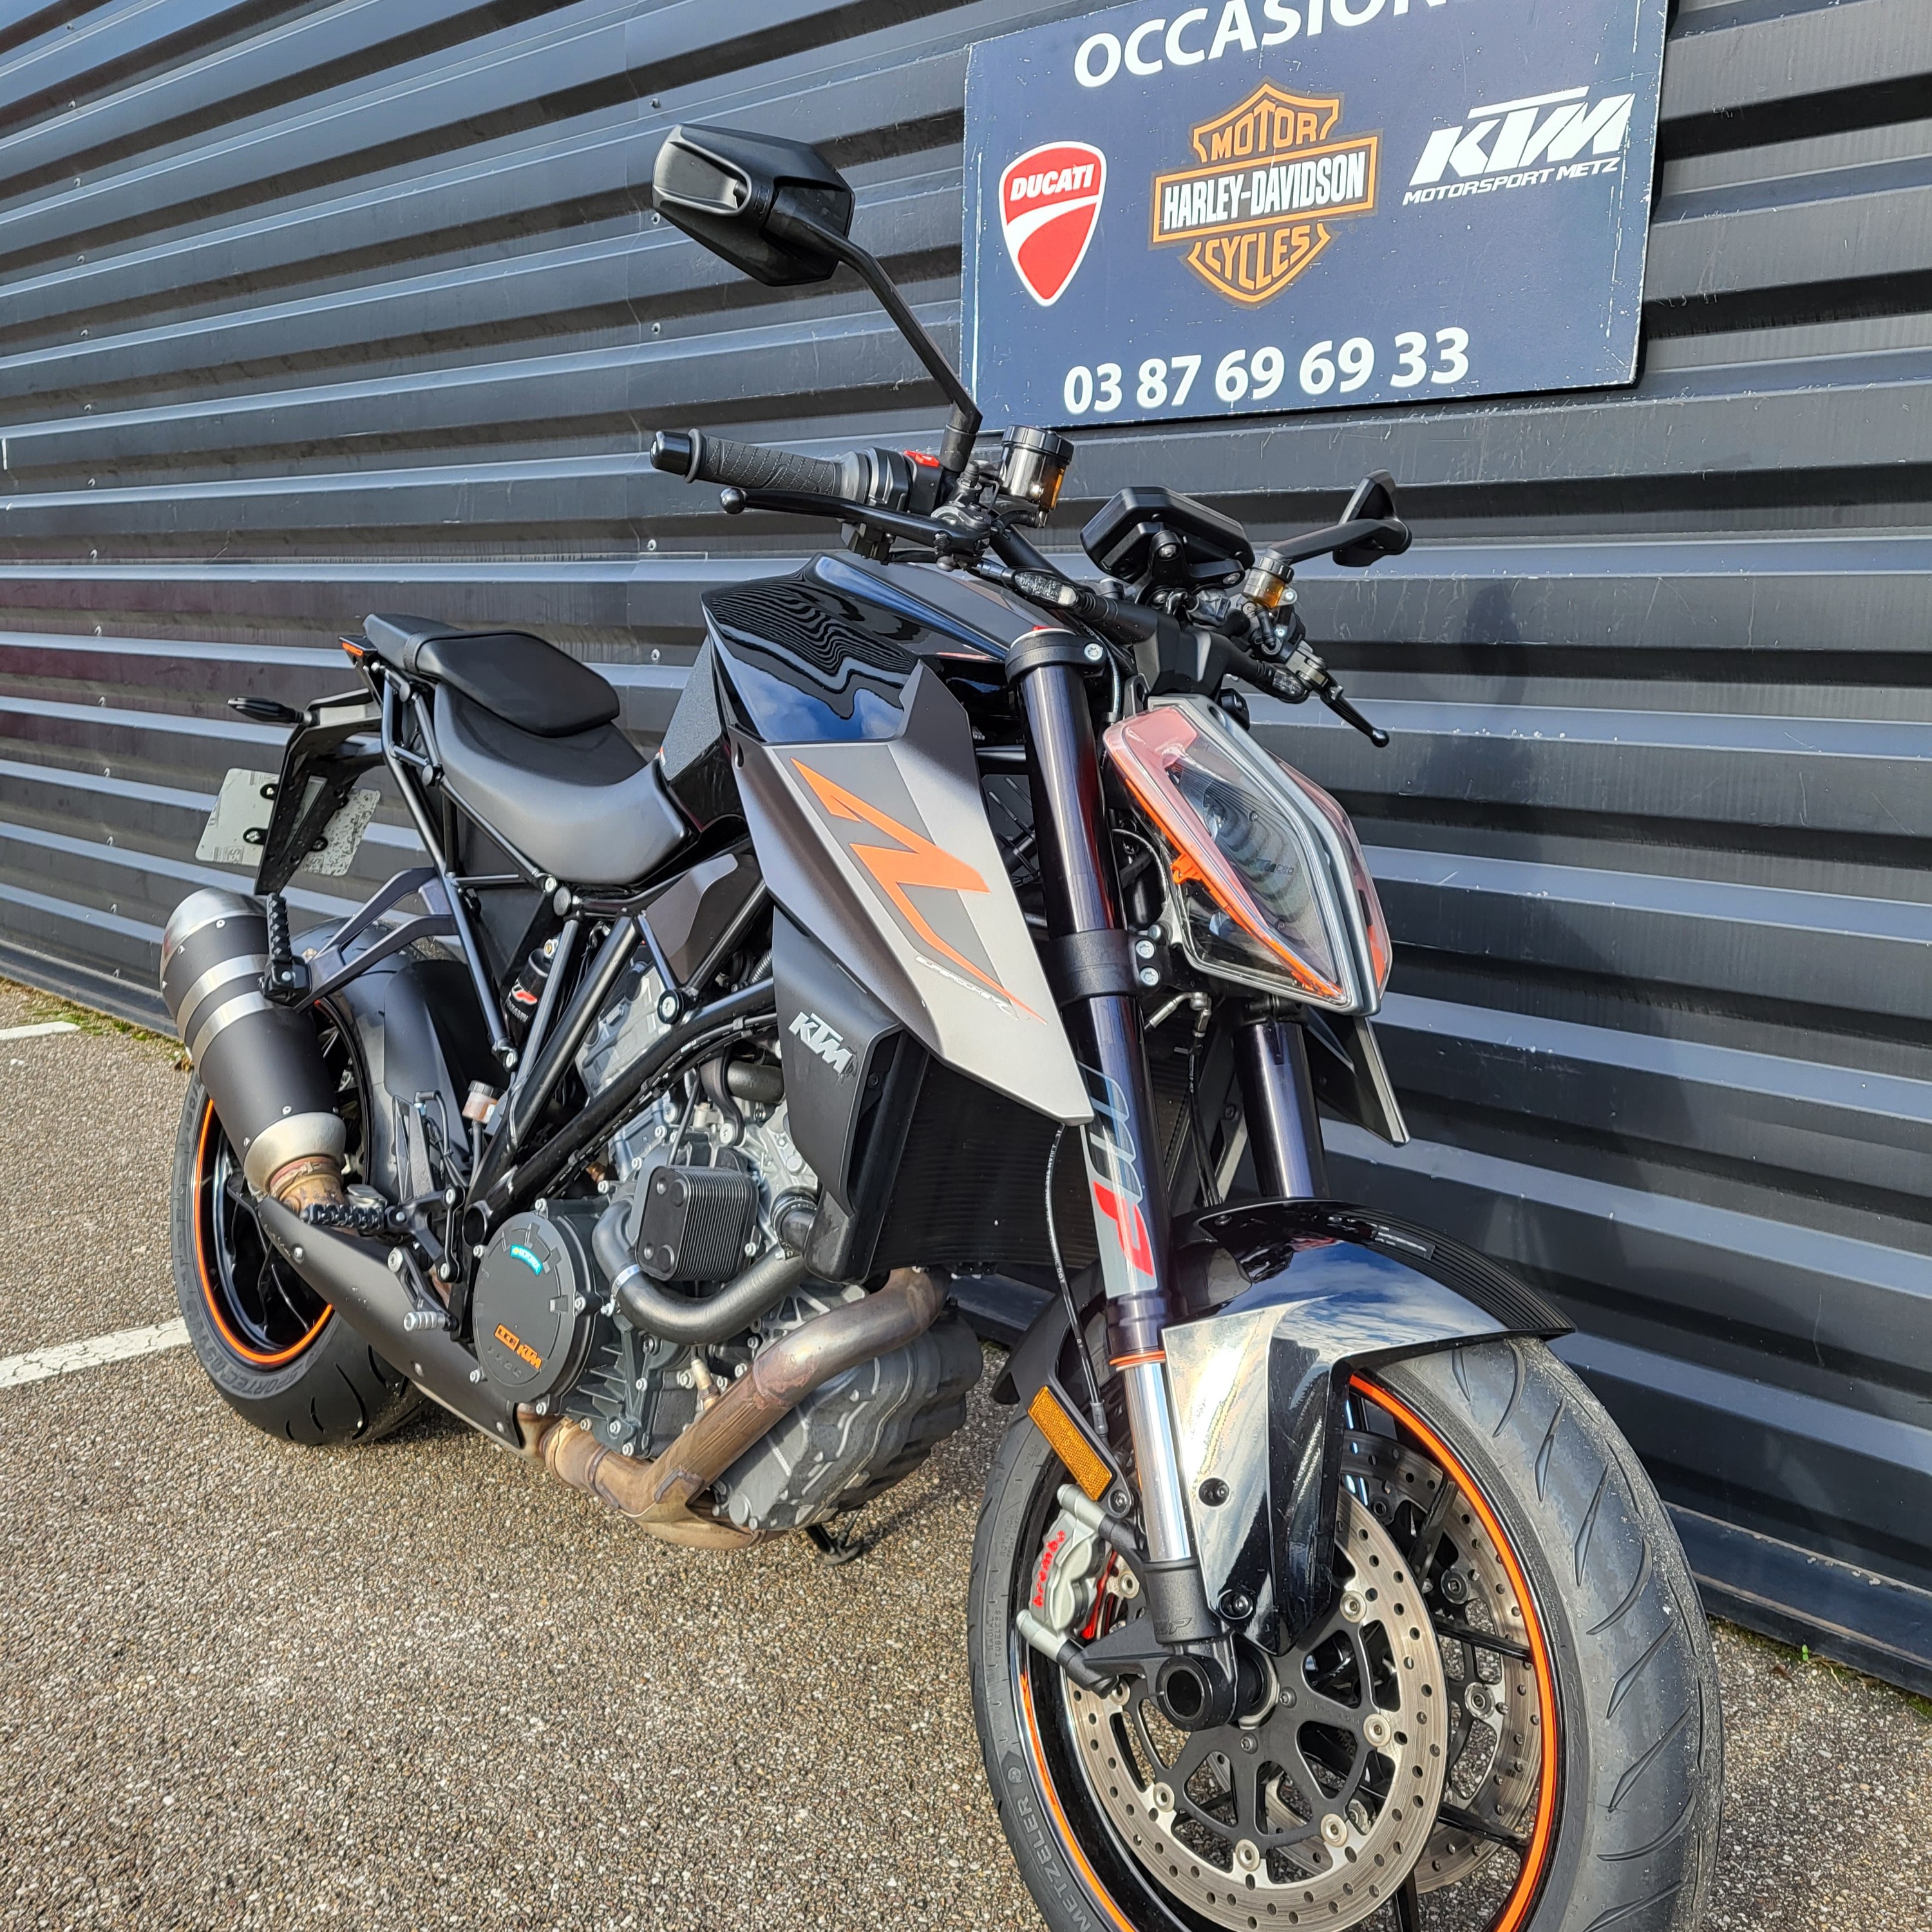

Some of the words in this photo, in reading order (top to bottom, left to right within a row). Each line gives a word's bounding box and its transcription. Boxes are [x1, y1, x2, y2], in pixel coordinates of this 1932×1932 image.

[1074, 0, 1447, 87] OCCASIO
[1211, 99, 1317, 160] MOTOR
[1409, 86, 1636, 186] KTM
[1010, 164, 1094, 201] DUCATI
[1164, 151, 1365, 230] HARLEY-DAVIDSON
[1403, 167, 1555, 205] MOTORSPORT
[1556, 157, 1621, 180] METZ
[1205, 225, 1311, 290] CYCLES
[1064, 363, 1122, 414] 03
[1136, 354, 1202, 409] 87
[1215, 346, 1285, 401] 69
[1299, 337, 1375, 395] 69
[1390, 327, 1469, 387] 33
[788, 1012, 853, 1074] KTM
[1017, 1795, 1093, 1932] METZELER
